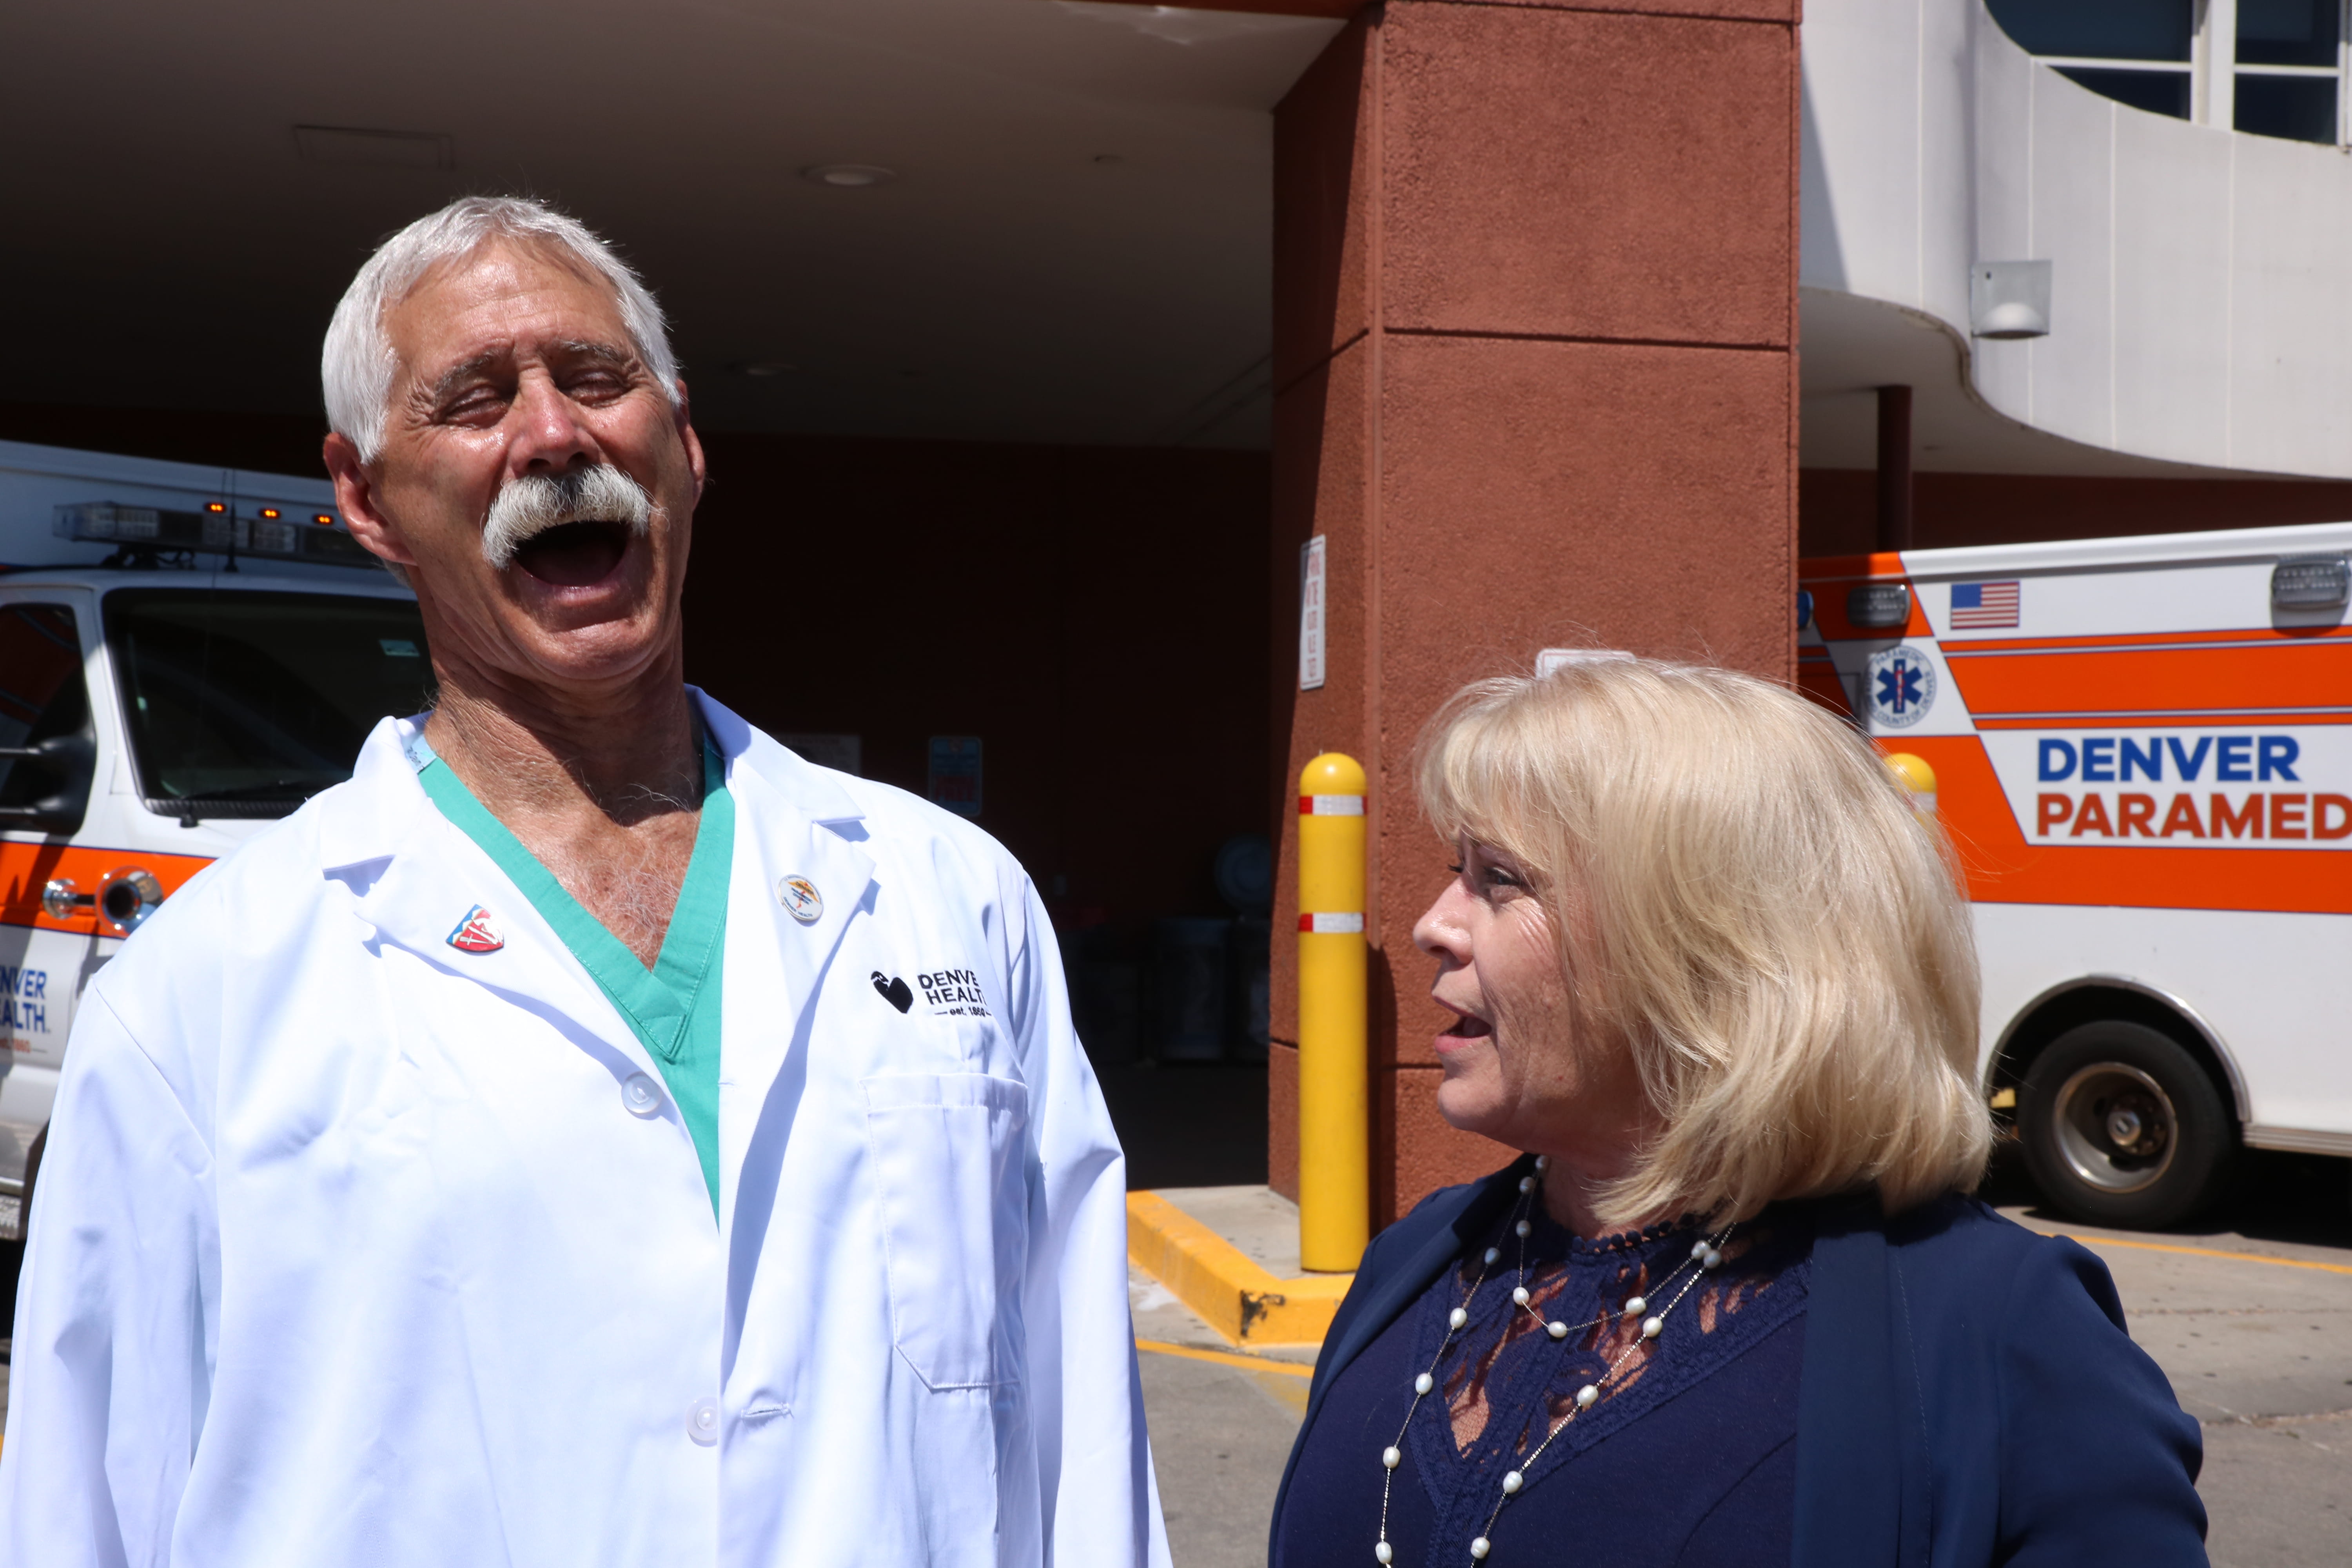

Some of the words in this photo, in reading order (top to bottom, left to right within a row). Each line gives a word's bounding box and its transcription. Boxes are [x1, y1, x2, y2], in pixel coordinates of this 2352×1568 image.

[2039, 735, 2300, 782] DENVER
[2038, 793, 2352, 839] PARAMED
[0, 965, 46, 999] NVER
[917, 969, 980, 989] DENVE
[0, 998, 45, 1033] ALTH
[949, 1007, 967, 1016] est.
